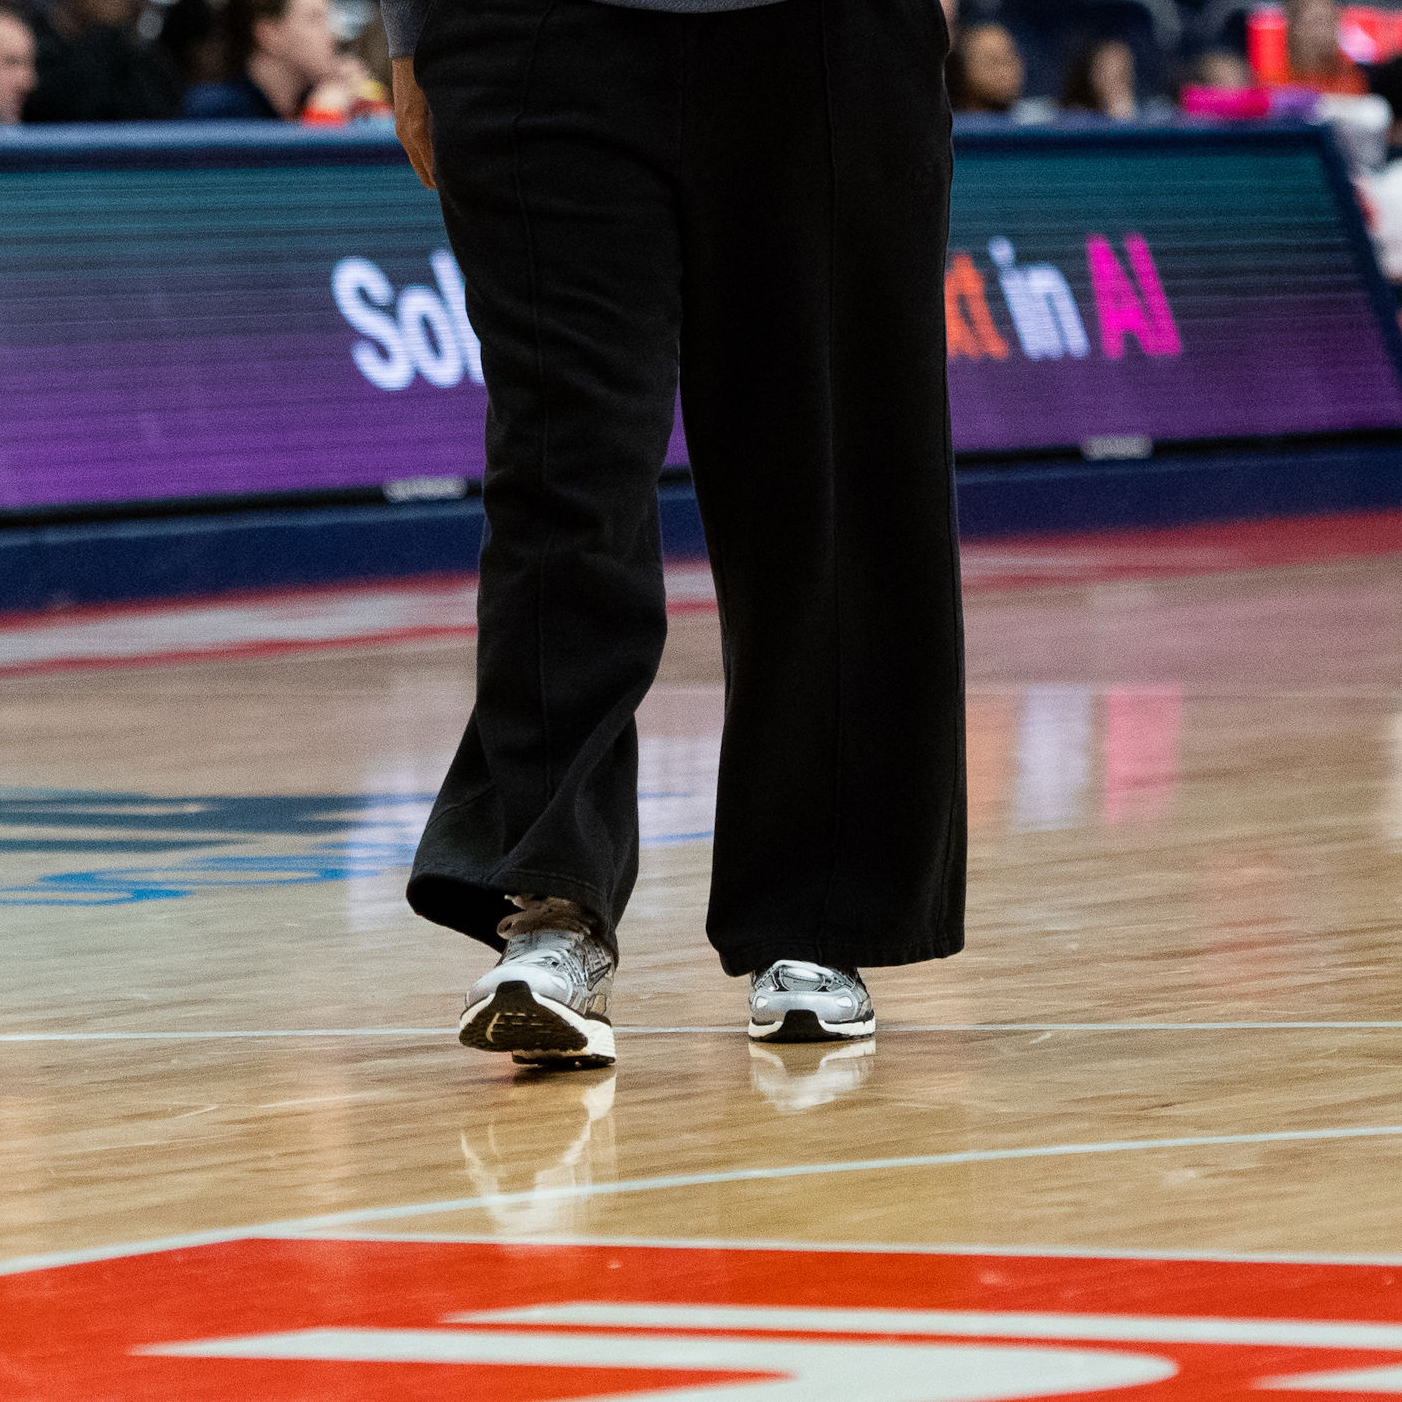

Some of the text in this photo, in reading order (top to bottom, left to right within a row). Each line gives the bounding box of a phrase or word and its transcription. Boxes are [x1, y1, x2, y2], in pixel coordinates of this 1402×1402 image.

[330, 248, 486, 392] Sol
[987, 234, 1091, 361] in
[1085, 230, 1183, 361] AI
